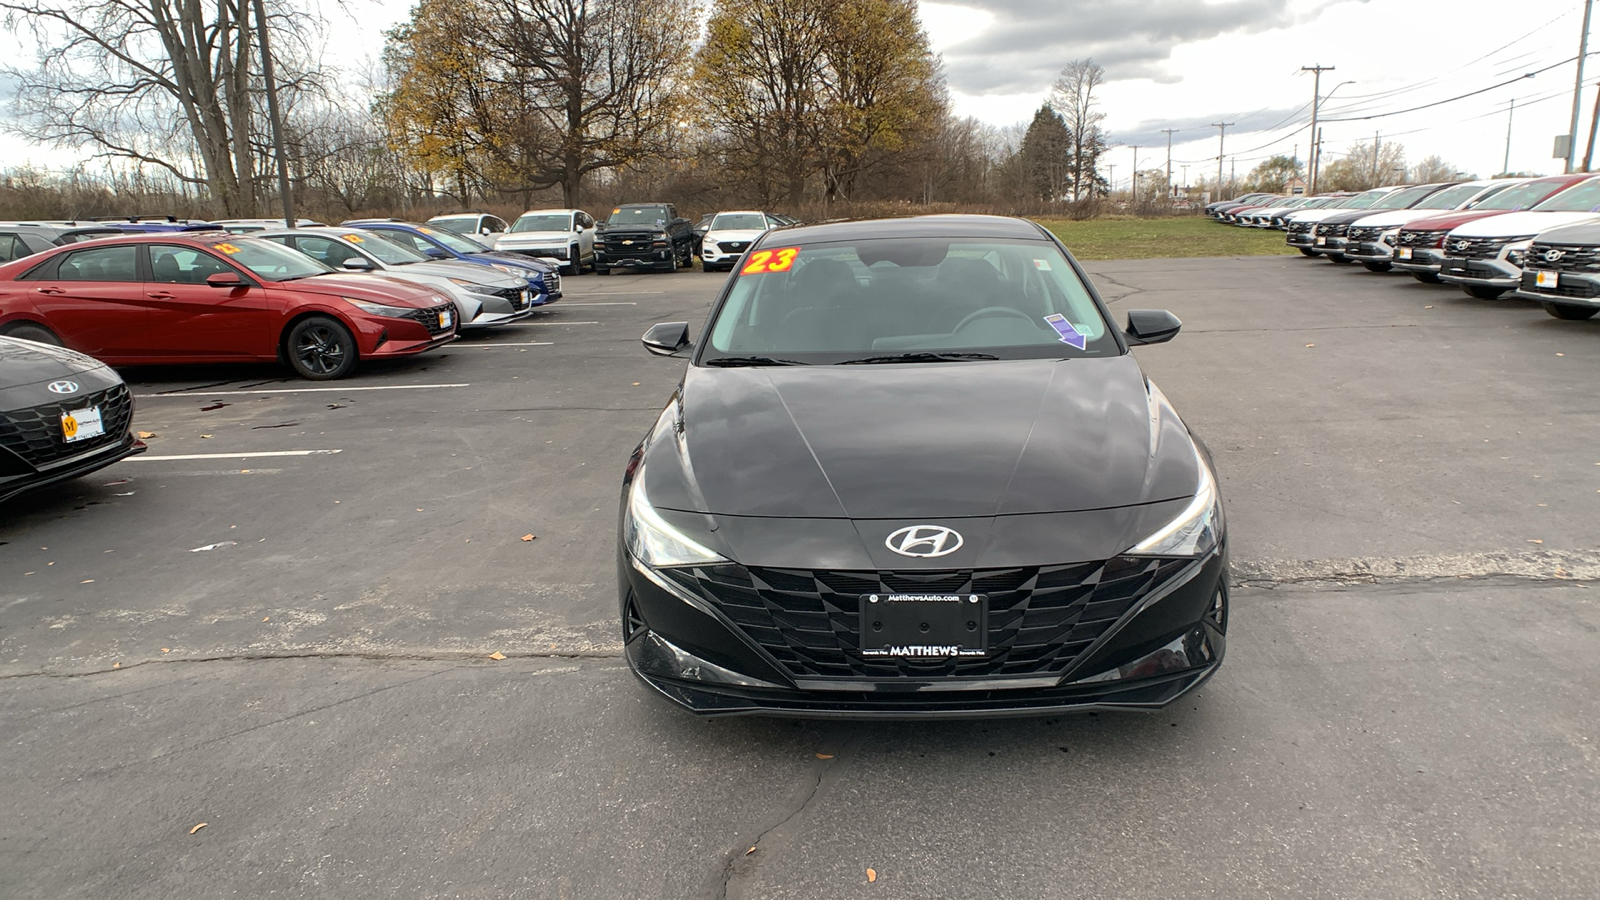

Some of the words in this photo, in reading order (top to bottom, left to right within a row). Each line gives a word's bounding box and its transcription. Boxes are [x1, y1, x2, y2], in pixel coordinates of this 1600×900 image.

[743, 248, 797, 273] 23
[65, 421, 75, 432] M
[888, 594, 960, 602] MatthewsAuto.com
[889, 645, 958, 656] MATTHEWS
